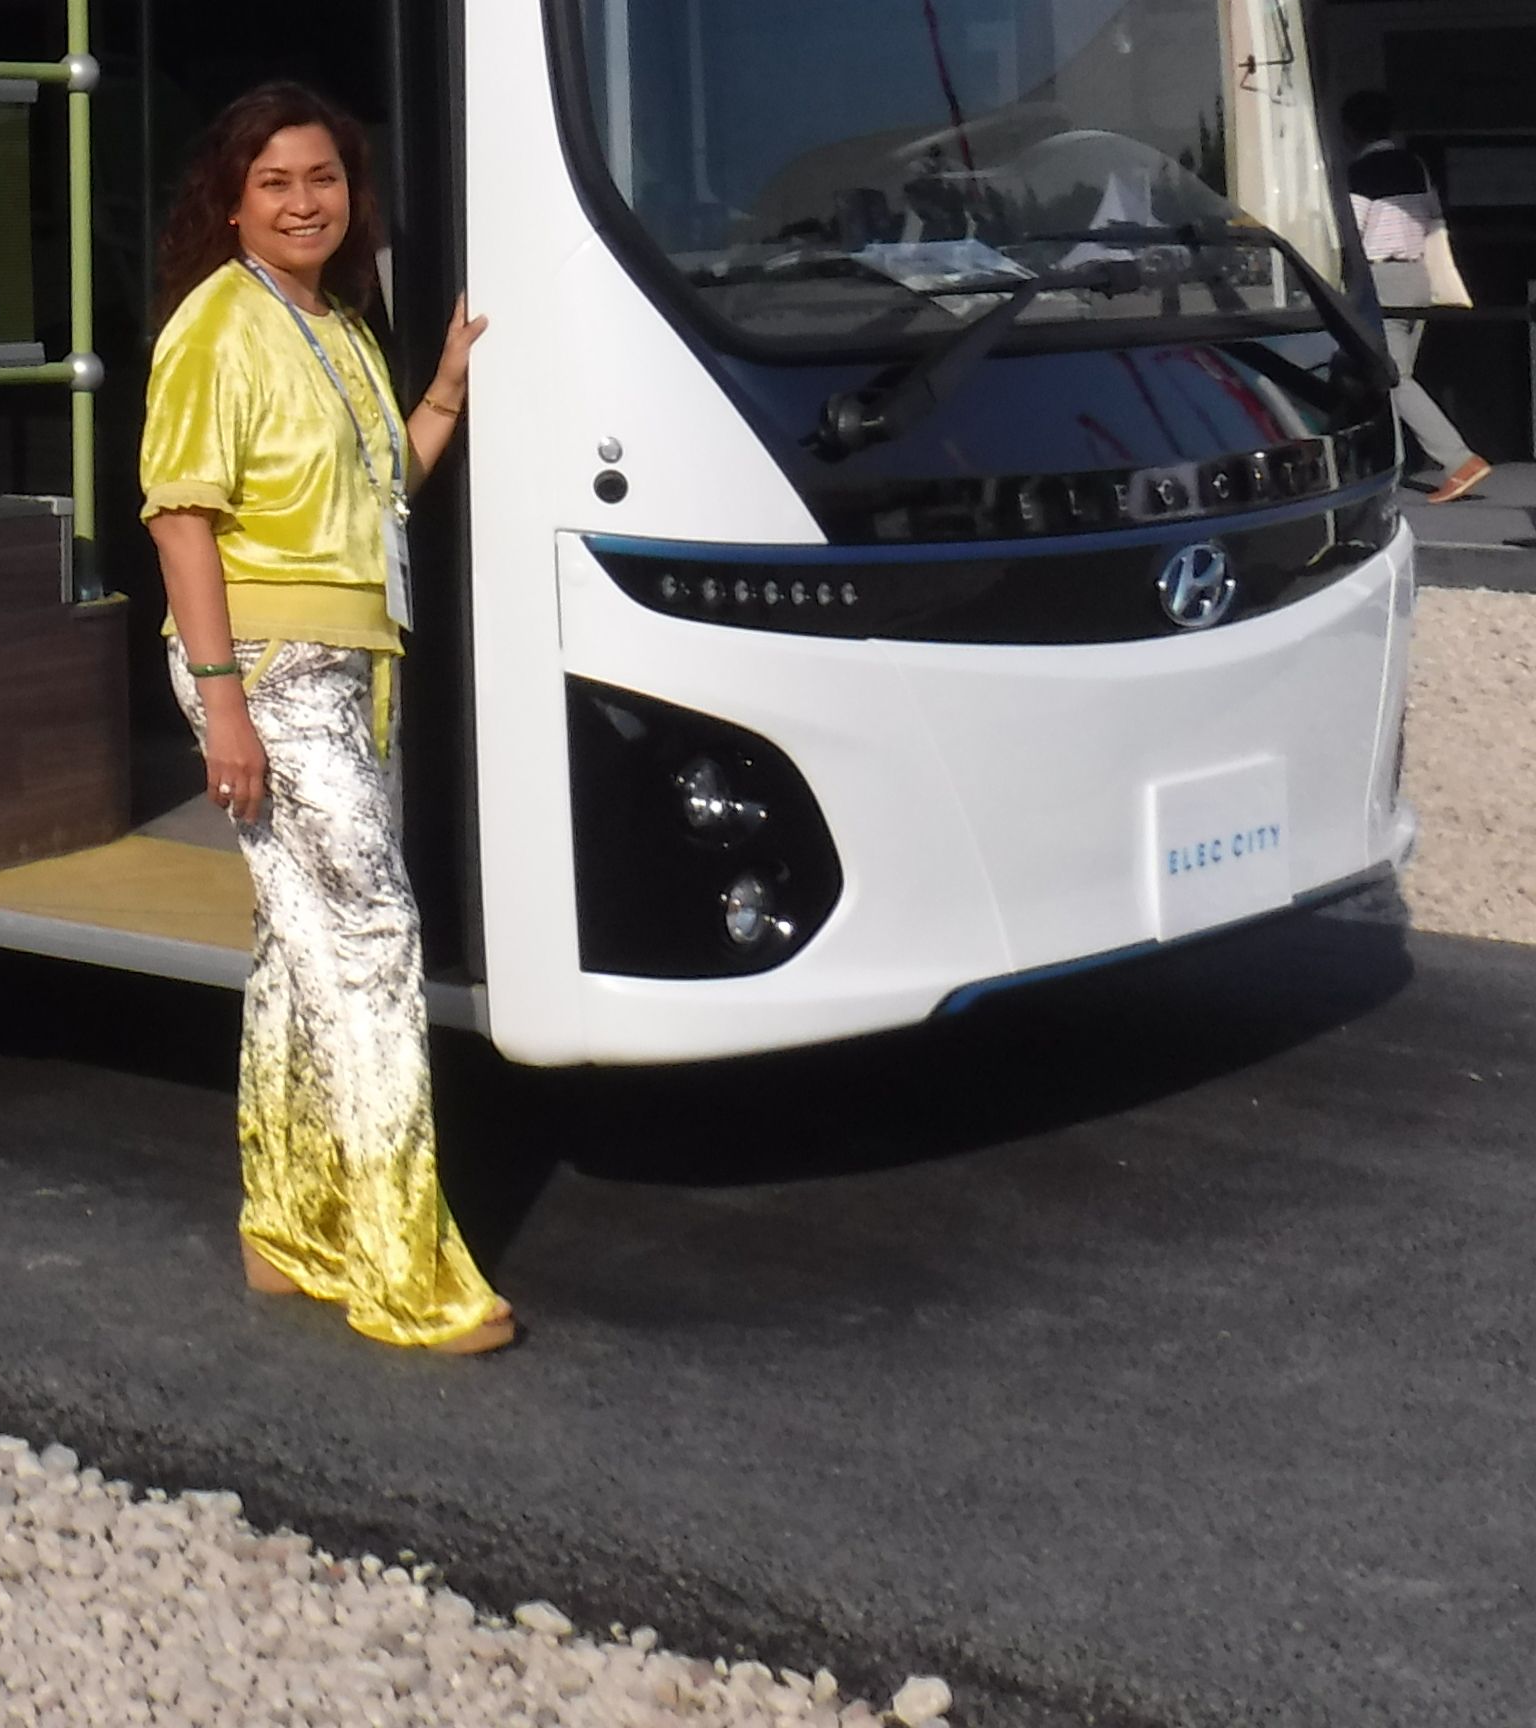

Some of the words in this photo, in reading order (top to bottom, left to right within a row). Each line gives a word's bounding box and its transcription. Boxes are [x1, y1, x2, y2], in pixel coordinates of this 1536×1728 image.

[1017, 478, 1175, 521] ELEC
[1168, 838, 1222, 875] ELEC
[1232, 824, 1281, 857] CITY
